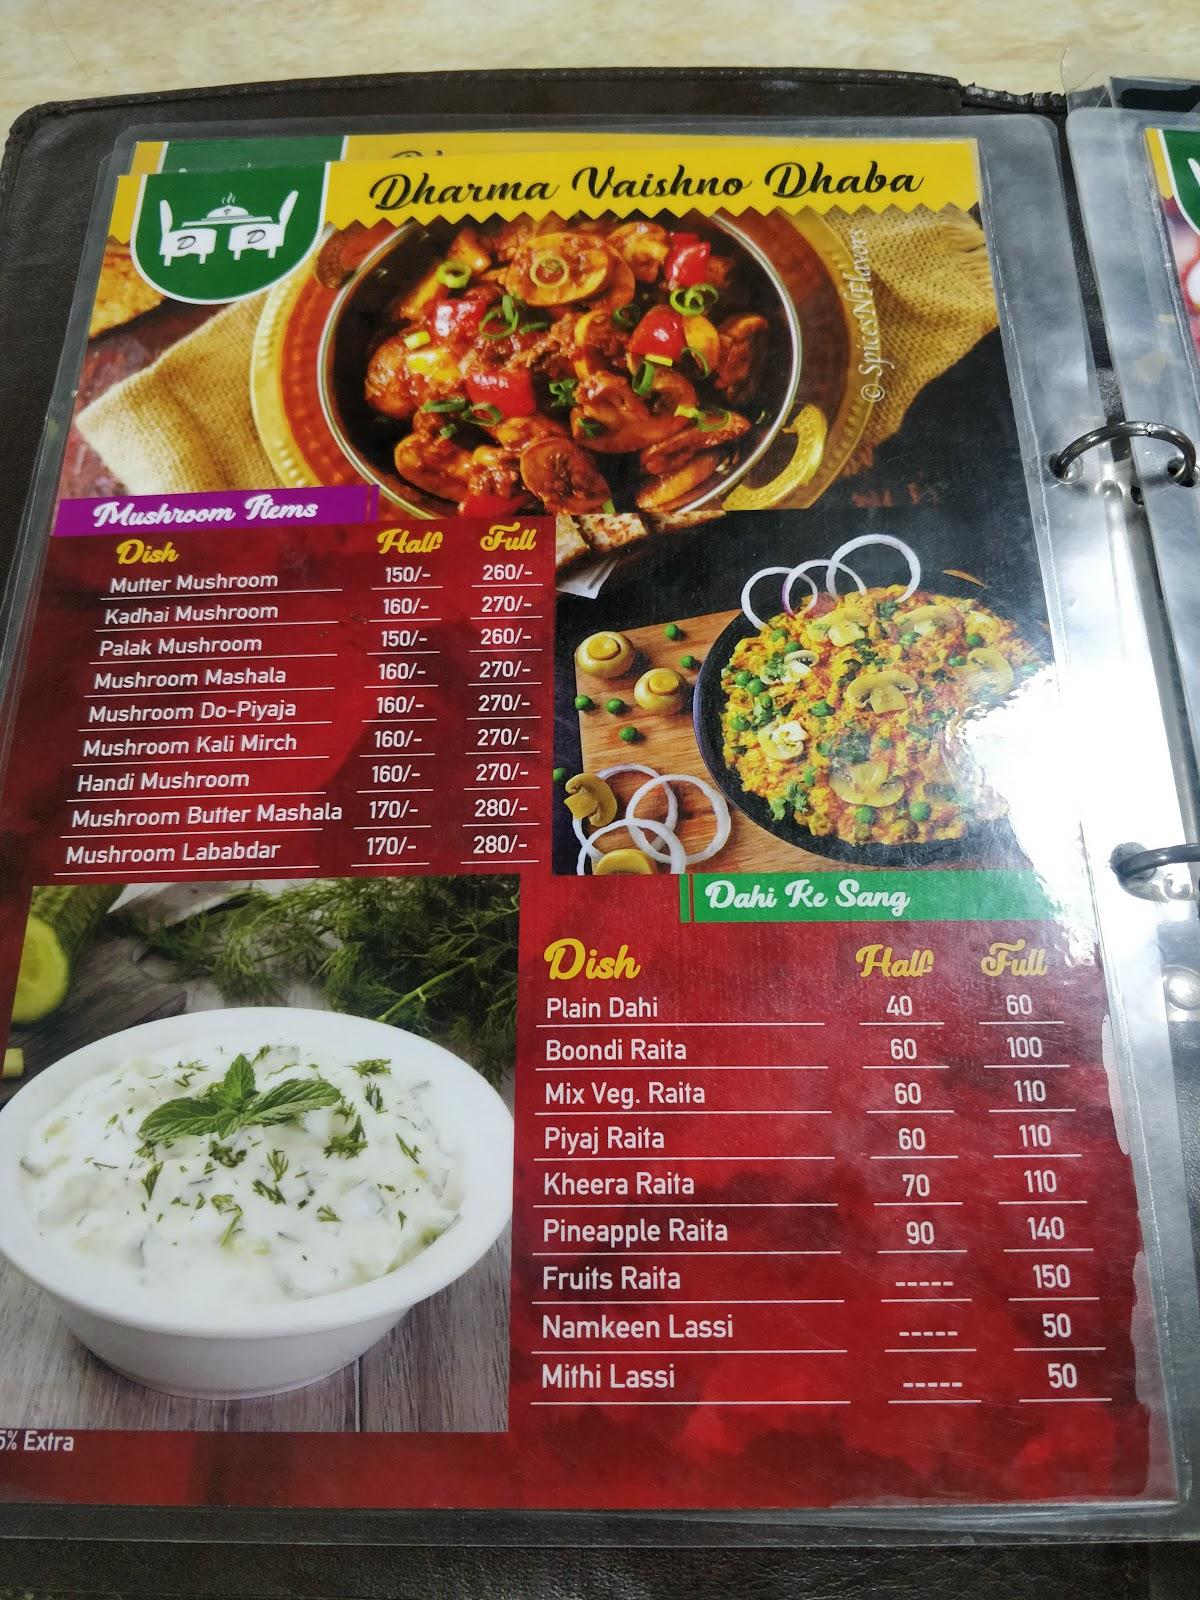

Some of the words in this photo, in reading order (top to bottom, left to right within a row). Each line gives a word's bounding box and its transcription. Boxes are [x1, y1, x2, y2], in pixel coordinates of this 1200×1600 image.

[369, 172, 560, 211] Dharma
[571, 165, 753, 200] Vaishno
[764, 160, 924, 199] Dhaba
[176, 235, 197, 251] D
[246, 229, 266, 244] D
[92, 499, 236, 529] Mushroom
[244, 493, 319, 521] Items
[376, 528, 444, 555] Half
[479, 521, 537, 552] Full
[116, 538, 180, 565] Dish
[110, 577, 172, 594] Mutter
[176, 573, 279, 591] Mushroom
[385, 566, 431, 583] 150/-
[482, 563, 533, 581] 260/-
[104, 606, 170, 625] Kadhai
[174, 604, 279, 622] Mushroom
[383, 597, 430, 615] 160/-
[481, 595, 532, 613] 270/-
[99, 638, 152, 657] Palak
[158, 636, 263, 655] Mushroom
[381, 629, 428, 647] 150/-
[480, 627, 532, 645] 260/-
[94, 671, 199, 690] Mushroom
[205, 666, 287, 686] Mashala
[378, 662, 426, 680] 160/-
[479, 660, 531, 678] 270/-
[88, 704, 194, 723] Mushroom
[200, 699, 297, 722] Do-Piyaja
[376, 695, 425, 714] 160/-
[478, 693, 531, 712] 270/-
[83, 738, 190, 757] Mushroom
[196, 734, 235, 754] Kali
[240, 733, 297, 752] Mirch
[374, 729, 423, 748] 160/-
[477, 727, 530, 746] 270/-
[77, 772, 135, 793] Handi
[140, 771, 250, 790] Mushroom
[371, 764, 421, 783] 160/-
[475, 762, 529, 782] 270/-
[71, 808, 180, 828] Mushroom
[187, 806, 252, 825] Butter
[256, 802, 343, 822] Mashala
[369, 799, 419, 819] 170/-
[474, 798, 528, 818] 280/-
[65, 845, 176, 865] Mushroom
[182, 840, 282, 861] Lababdar
[366, 836, 417, 856] 170/-
[473, 834, 528, 854] 280/-
[704, 879, 778, 909] Dahi
[784, 878, 829, 908] Ke
[834, 878, 911, 917] Sang
[543, 937, 641, 980] Dish
[855, 943, 935, 978] Half
[980, 938, 1047, 977] Full
[546, 997, 601, 1019] Plain
[609, 996, 658, 1018] Dahi
[886, 995, 913, 1017] 40
[1006, 993, 1033, 1016] 60
[546, 1038, 623, 1061] Boondi
[630, 1038, 687, 1060] Raita
[890, 1038, 918, 1060] 60
[1006, 1036, 1043, 1059] 100
[545, 1082, 585, 1105] Mix
[591, 1081, 641, 1110] Veg.
[648, 1081, 706, 1104] Raita
[894, 1082, 922, 1105] 60
[1013, 1079, 1047, 1103] 110
[544, 1126, 599, 1156] Piyaj
[607, 1126, 665, 1149] Raita
[898, 1127, 926, 1151] 60
[1018, 1124, 1052, 1147] 110
[544, 1172, 629, 1196] Kheera
[636, 1171, 695, 1195] Raita
[901, 1173, 930, 1197] 70
[1023, 1169, 1057, 1193] 110
[543, 1218, 661, 1249] Pineapple
[669, 1217, 728, 1242] Raita
[906, 1221, 935, 1245] 90
[1027, 1216, 1065, 1241] 140
[543, 1266, 613, 1290] Fruits
[621, 1265, 681, 1290] Raita
[1032, 1263, 1071, 1289] 150
[542, 1314, 660, 1339] Namkeen
[668, 1313, 733, 1339] Lassi
[1042, 1312, 1072, 1338] 50
[542, 1363, 601, 1389] Mithi
[610, 1363, 675, 1389] Lassi
[1047, 1362, 1078, 1389] 50
[23, 1430, 75, 1452] Extra
